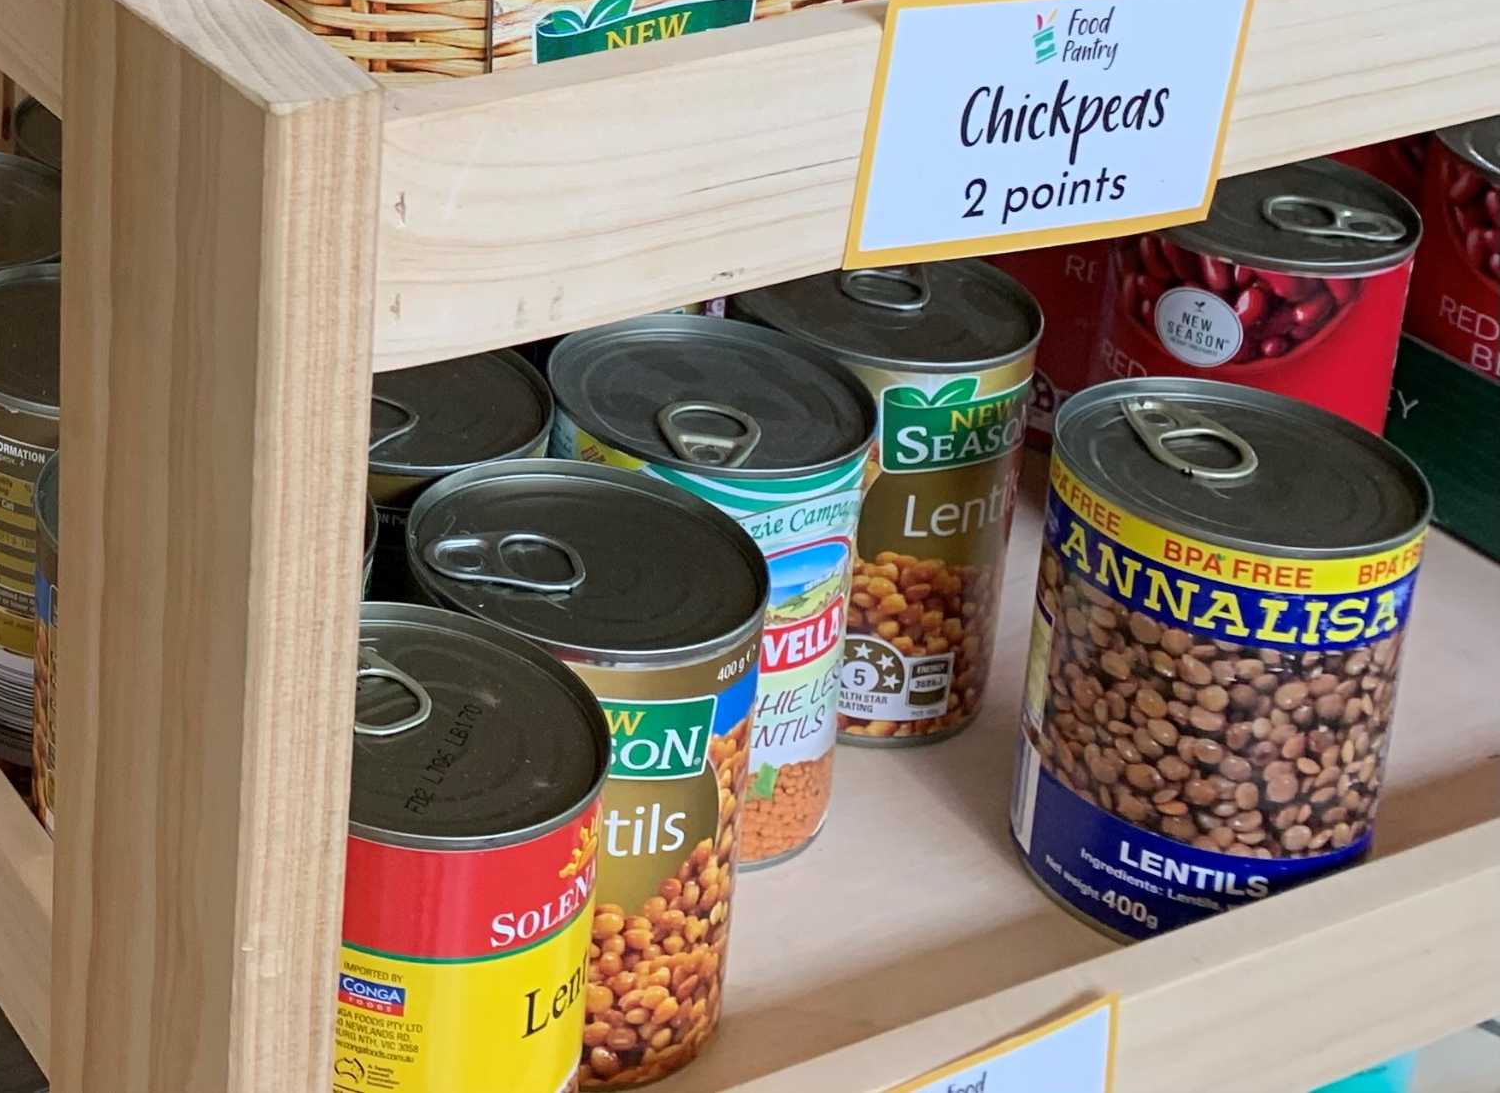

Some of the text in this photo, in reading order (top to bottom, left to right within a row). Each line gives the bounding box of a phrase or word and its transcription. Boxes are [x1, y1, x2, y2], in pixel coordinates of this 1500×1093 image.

[606, 11, 690, 50] NEW
[1066, 5, 1112, 38] Food
[1062, 37, 1119, 71] Pantry
[959, 79, 1170, 164] Chickpeas
[962, 167, 1126, 225] 2 points
[1181, 312, 1212, 332] NEW
[1439, 294, 1500, 342] RED
[950, 395, 1017, 432] NEW
[752, 513, 785, 540] zie
[1071, 484, 1121, 537] FREE
[1060, 519, 1399, 646] ANNALISA
[1163, 538, 1314, 589] BPA FREE
[1357, 541, 1422, 586] BPA FR
[763, 605, 842, 668] VELLA
[717, 656, 745, 682] 400 g
[853, 668, 867, 686] 5
[838, 699, 874, 713] RATING
[840, 690, 888, 704] ALTH STAR
[604, 802, 687, 858] tils
[1080, 846, 1164, 895] Ingredients:
[1119, 839, 1270, 899] LENTILS
[489, 865, 595, 948] SOLEN
[1045, 854, 1159, 930] Net weight 400g
[342, 977, 402, 1003] CONGA
[343, 962, 404, 983] IMPORTED BY
[345, 1019, 395, 1040] NEWLANDS
[354, 1012, 423, 1034] FOODS PTY LTD
[381, 1039, 396, 1051] VIC
